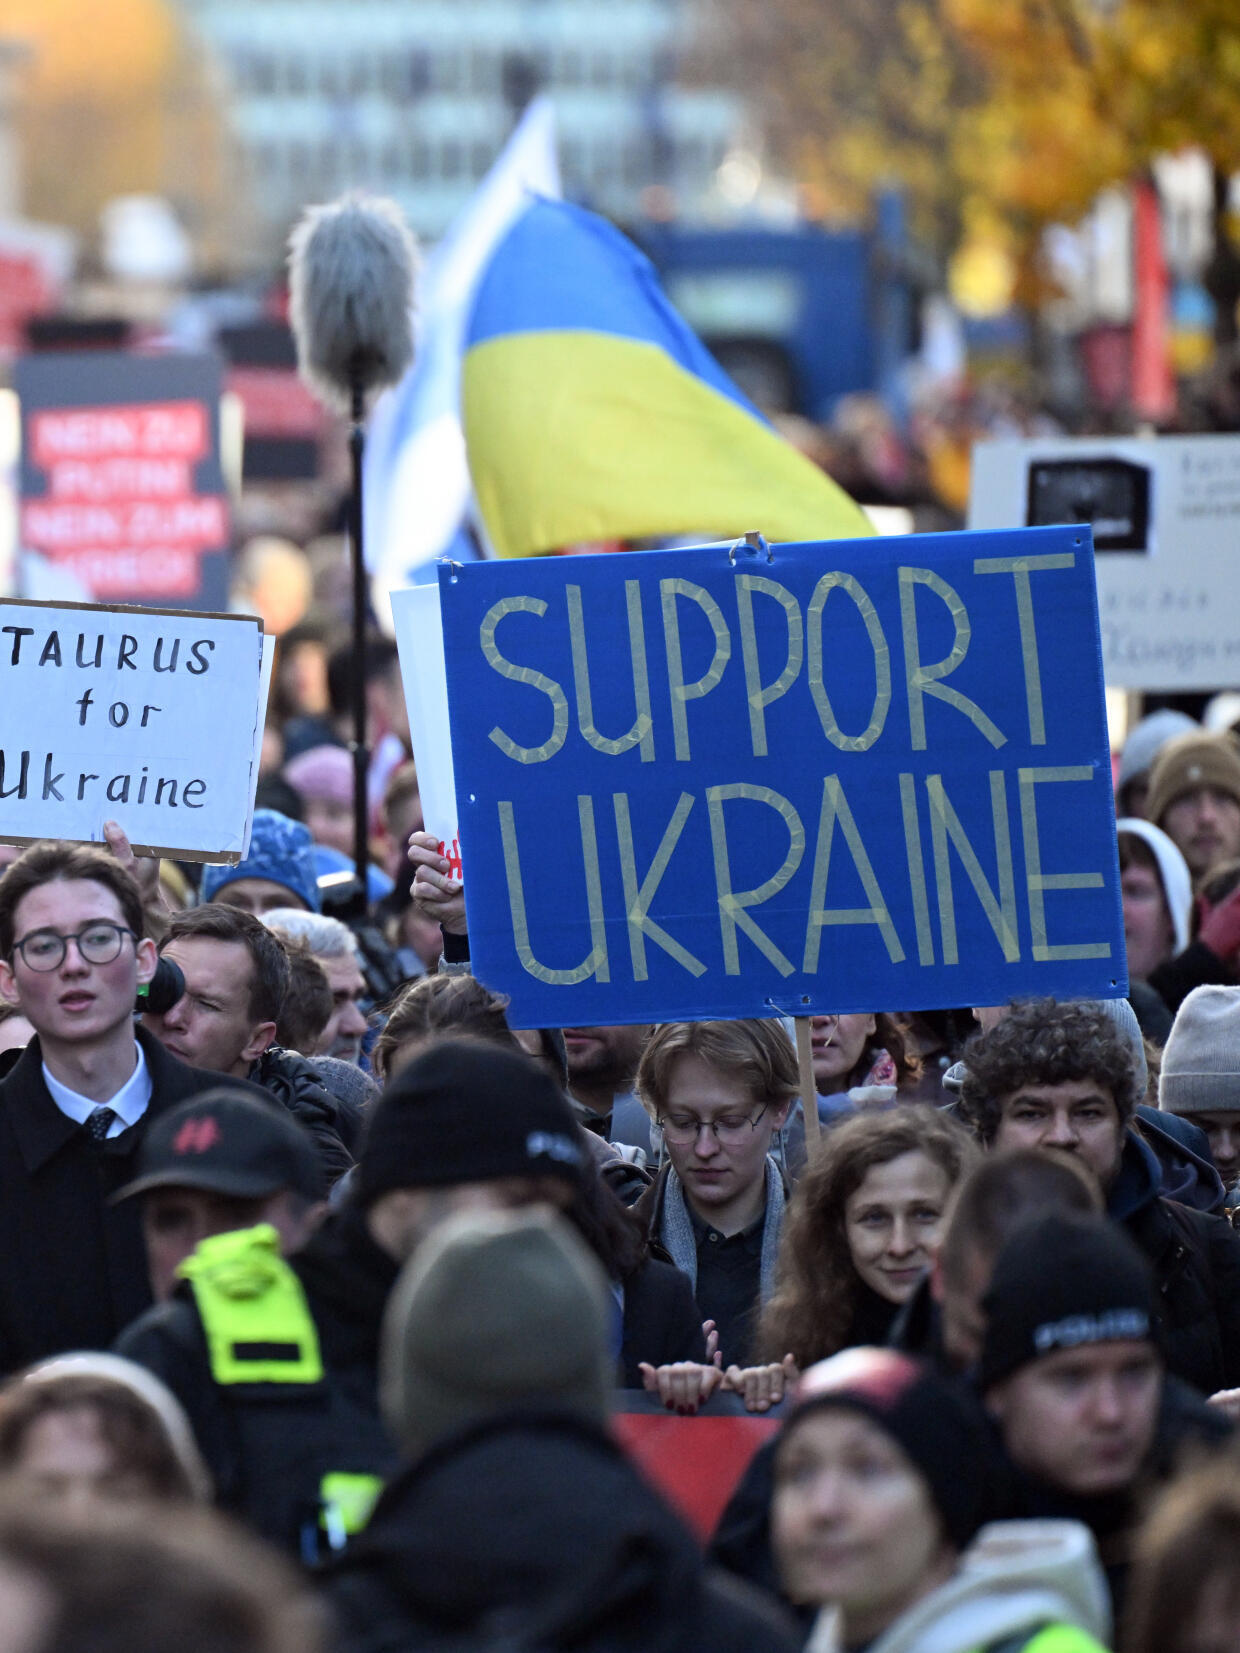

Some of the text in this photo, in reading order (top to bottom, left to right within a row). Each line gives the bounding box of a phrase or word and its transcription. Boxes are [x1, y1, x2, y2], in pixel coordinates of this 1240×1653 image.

[2, 626, 216, 675] TAURUS
[76, 688, 162, 728] for
[479, 552, 1075, 764] SUPPORT
[497, 765, 1111, 985] UKRAINE
